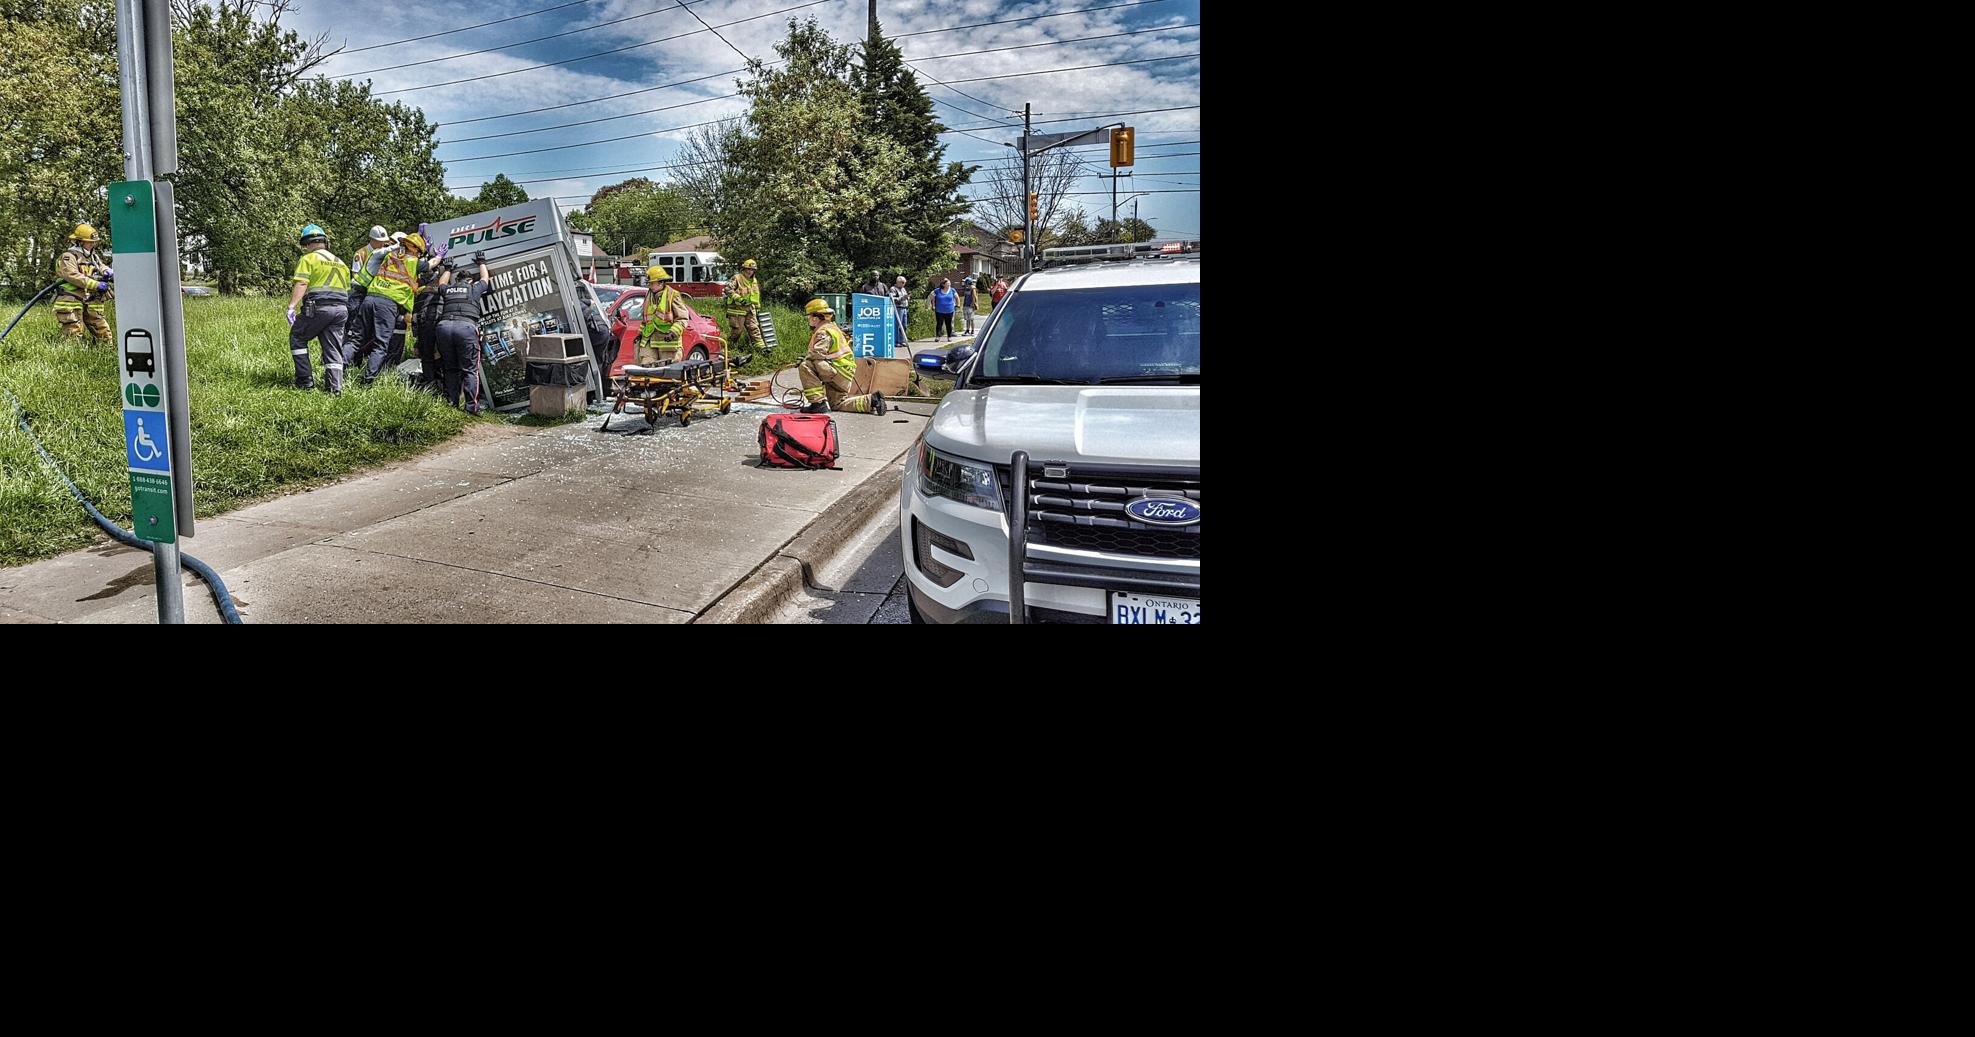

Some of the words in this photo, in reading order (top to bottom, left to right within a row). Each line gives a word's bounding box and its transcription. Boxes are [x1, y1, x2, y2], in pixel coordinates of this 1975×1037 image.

[448, 219, 536, 250] PULSE
[489, 270, 515, 291] TIME
[516, 263, 538, 282] FOR
[540, 260, 549, 275] A
[480, 276, 554, 316] LAYCATION
[857, 307, 881, 317] JOB
[134, 485, 168, 495] gotransit.com
[1143, 502, 1186, 519] Ford
[1146, 599, 1189, 610] ONTARIO
